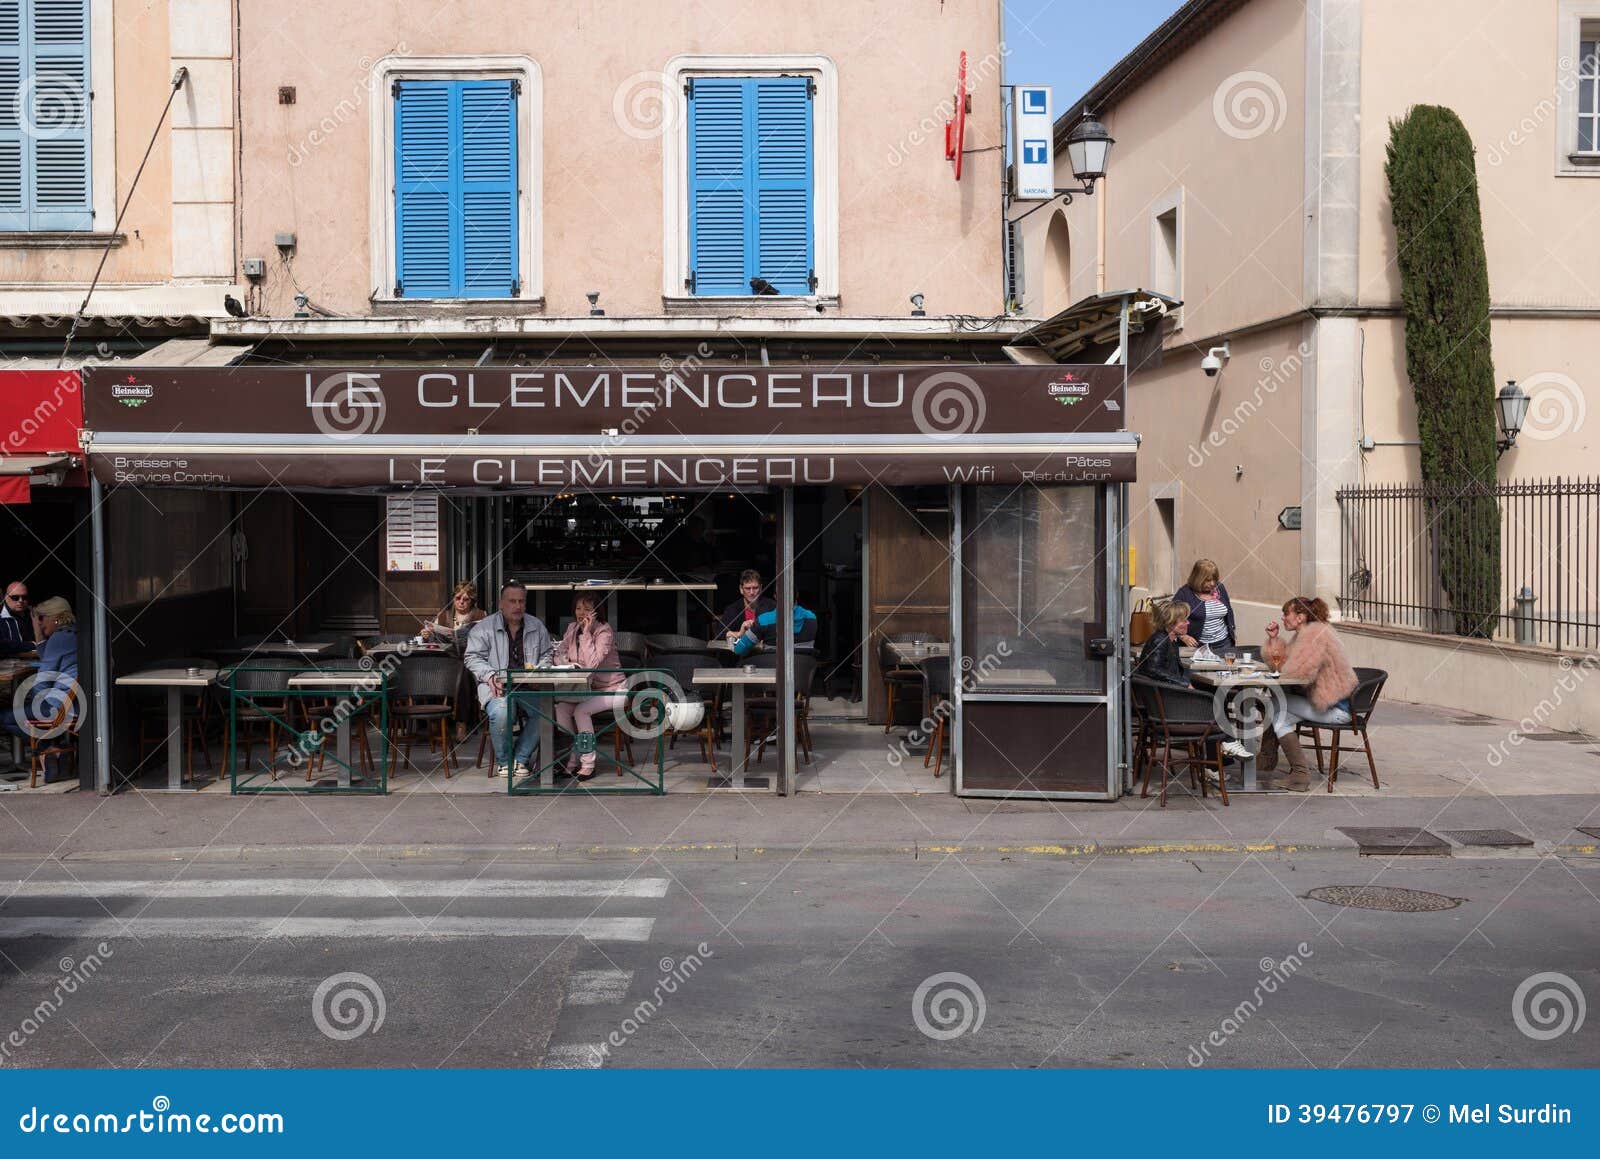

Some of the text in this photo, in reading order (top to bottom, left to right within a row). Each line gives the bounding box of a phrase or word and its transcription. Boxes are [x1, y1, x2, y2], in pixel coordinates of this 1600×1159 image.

[1024, 92, 1045, 112] L
[1024, 141, 1046, 162] T
[114, 386, 151, 395] Heineken
[305, 373, 904, 408] LE CLEMENCEAU
[1050, 384, 1087, 394] Heineken
[114, 457, 188, 468] Brasserie
[1066, 456, 1112, 468] Pâtes
[389, 457, 835, 485] LE CLEMENCEAU
[942, 465, 995, 482] Wifi
[1022, 471, 1112, 481] Plat du Jour
[114, 472, 231, 483] Service Continu
